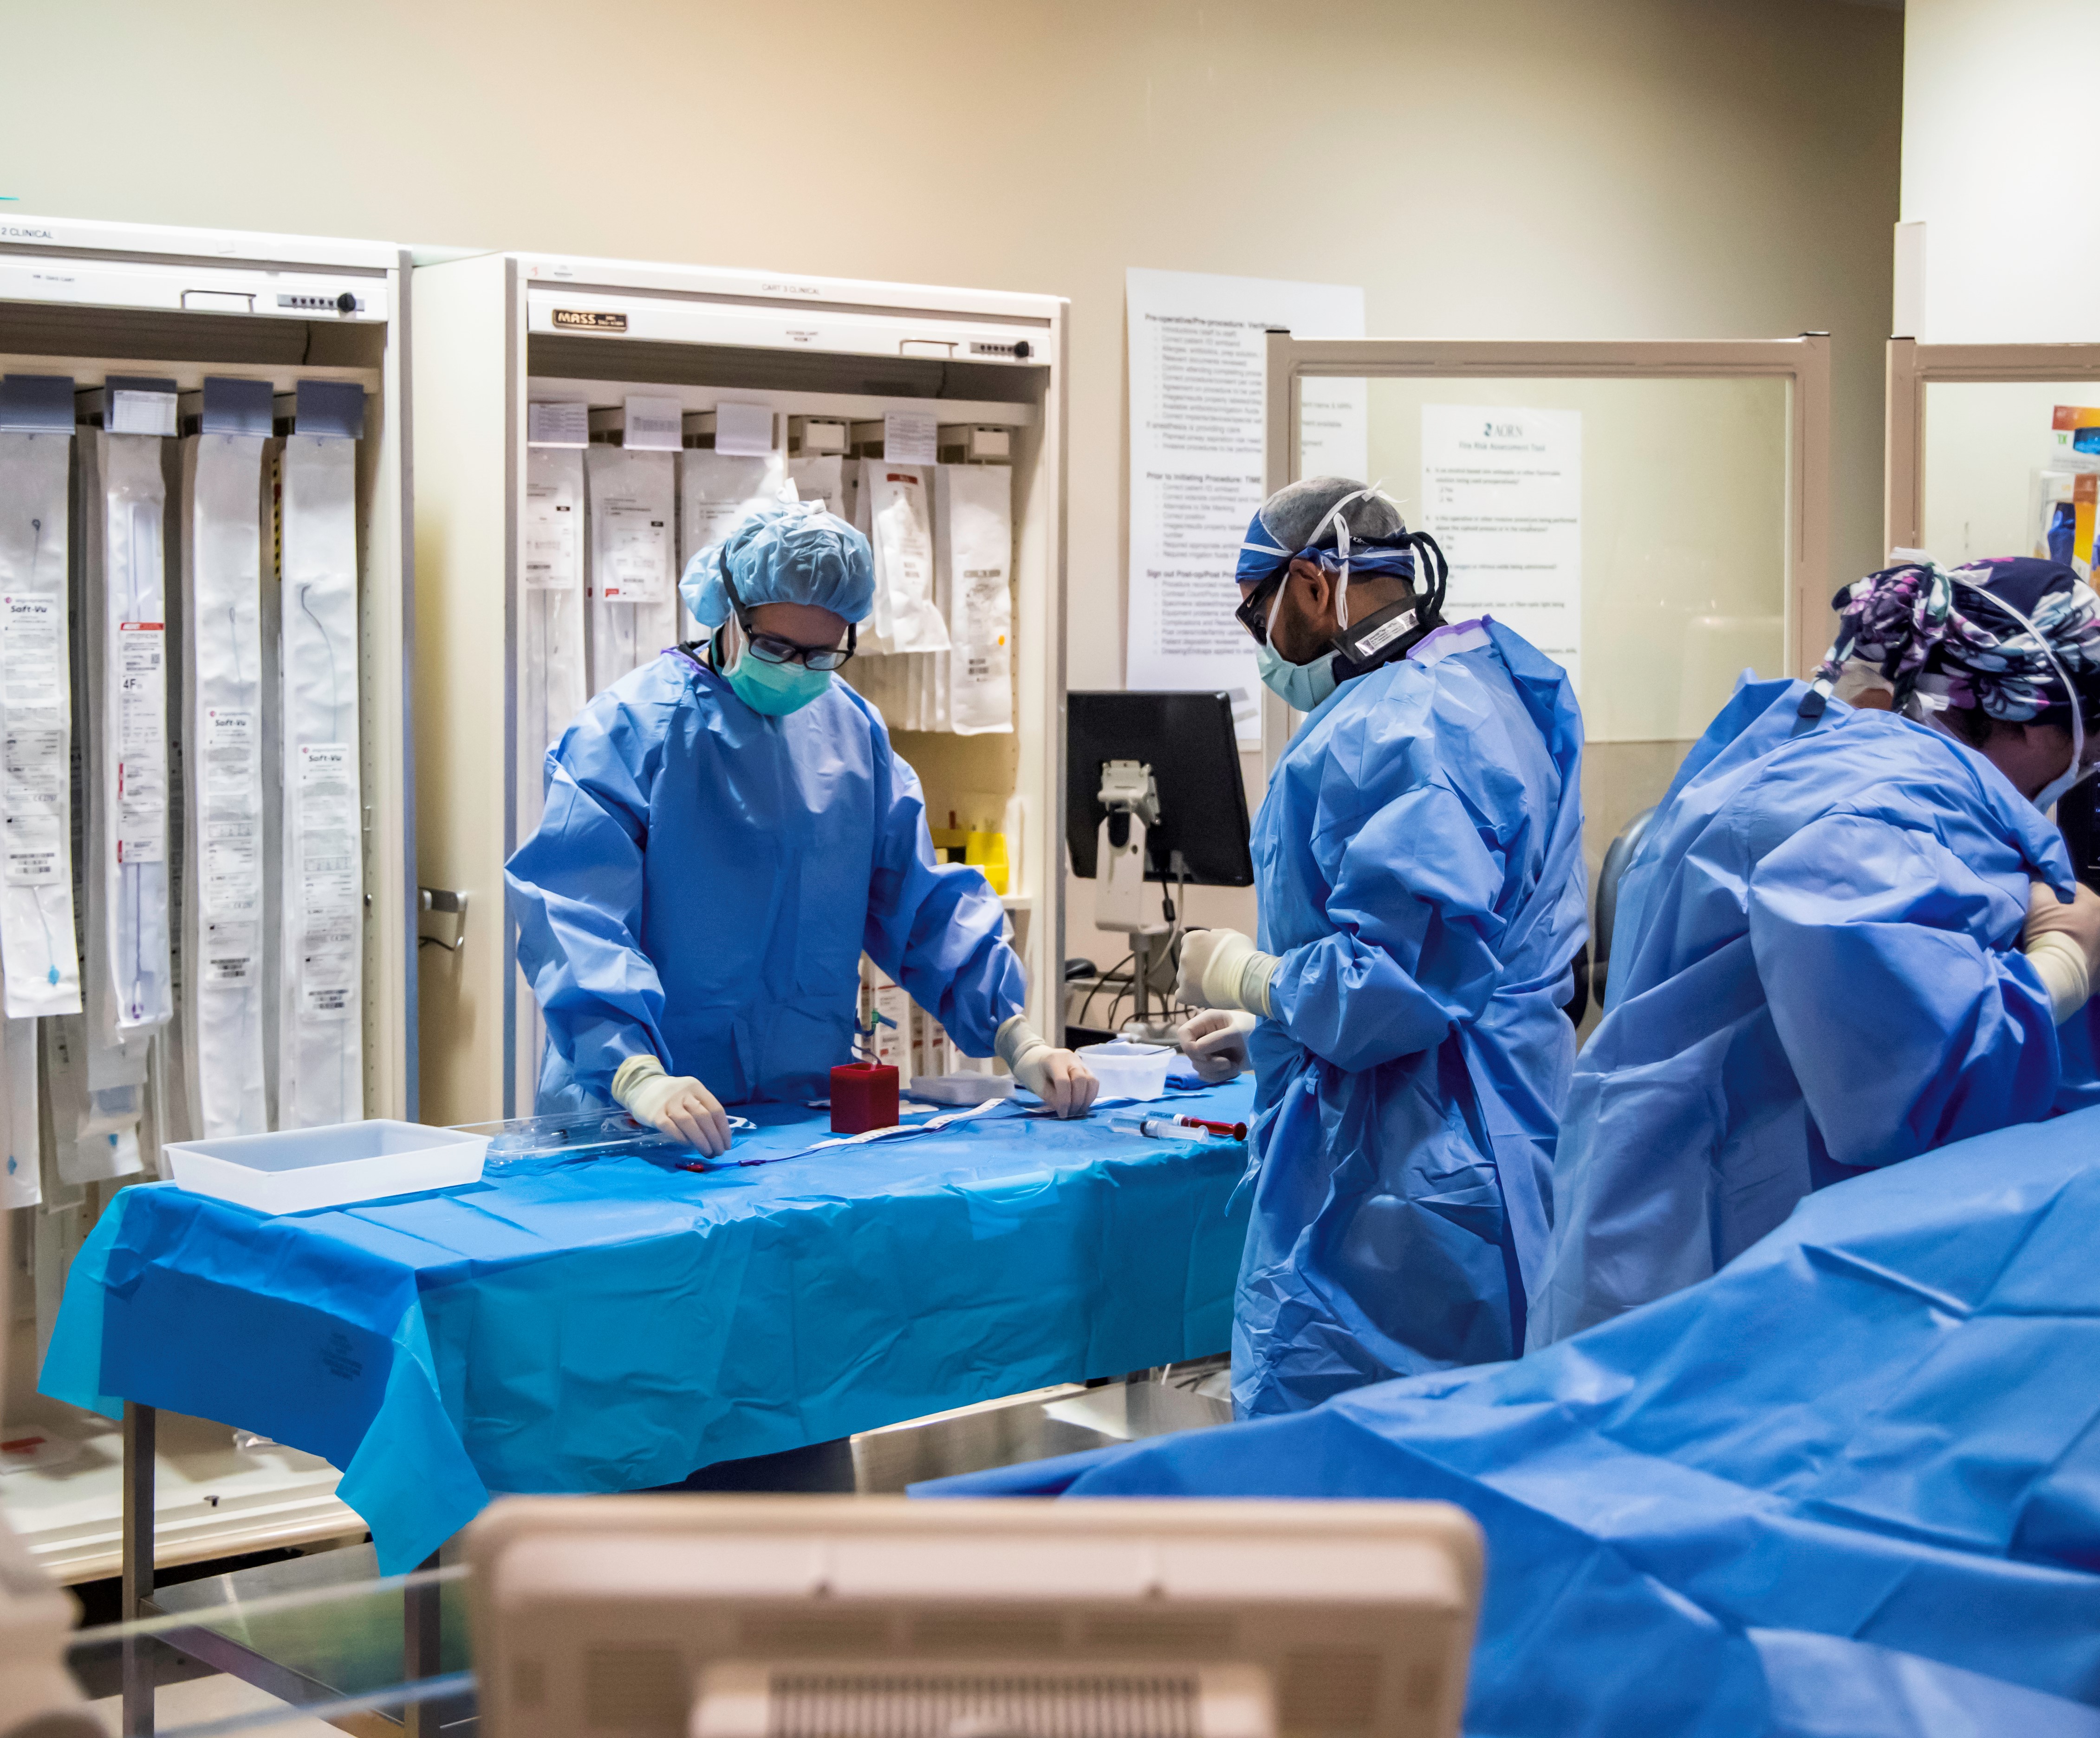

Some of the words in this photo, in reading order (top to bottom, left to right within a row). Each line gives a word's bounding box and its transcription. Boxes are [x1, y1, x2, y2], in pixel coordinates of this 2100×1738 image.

[1, 227, 7, 235] 2
[9, 228, 54, 239] CLINICAL
[789, 286, 820, 295] CLINICAL
[558, 312, 597, 324] MASS
